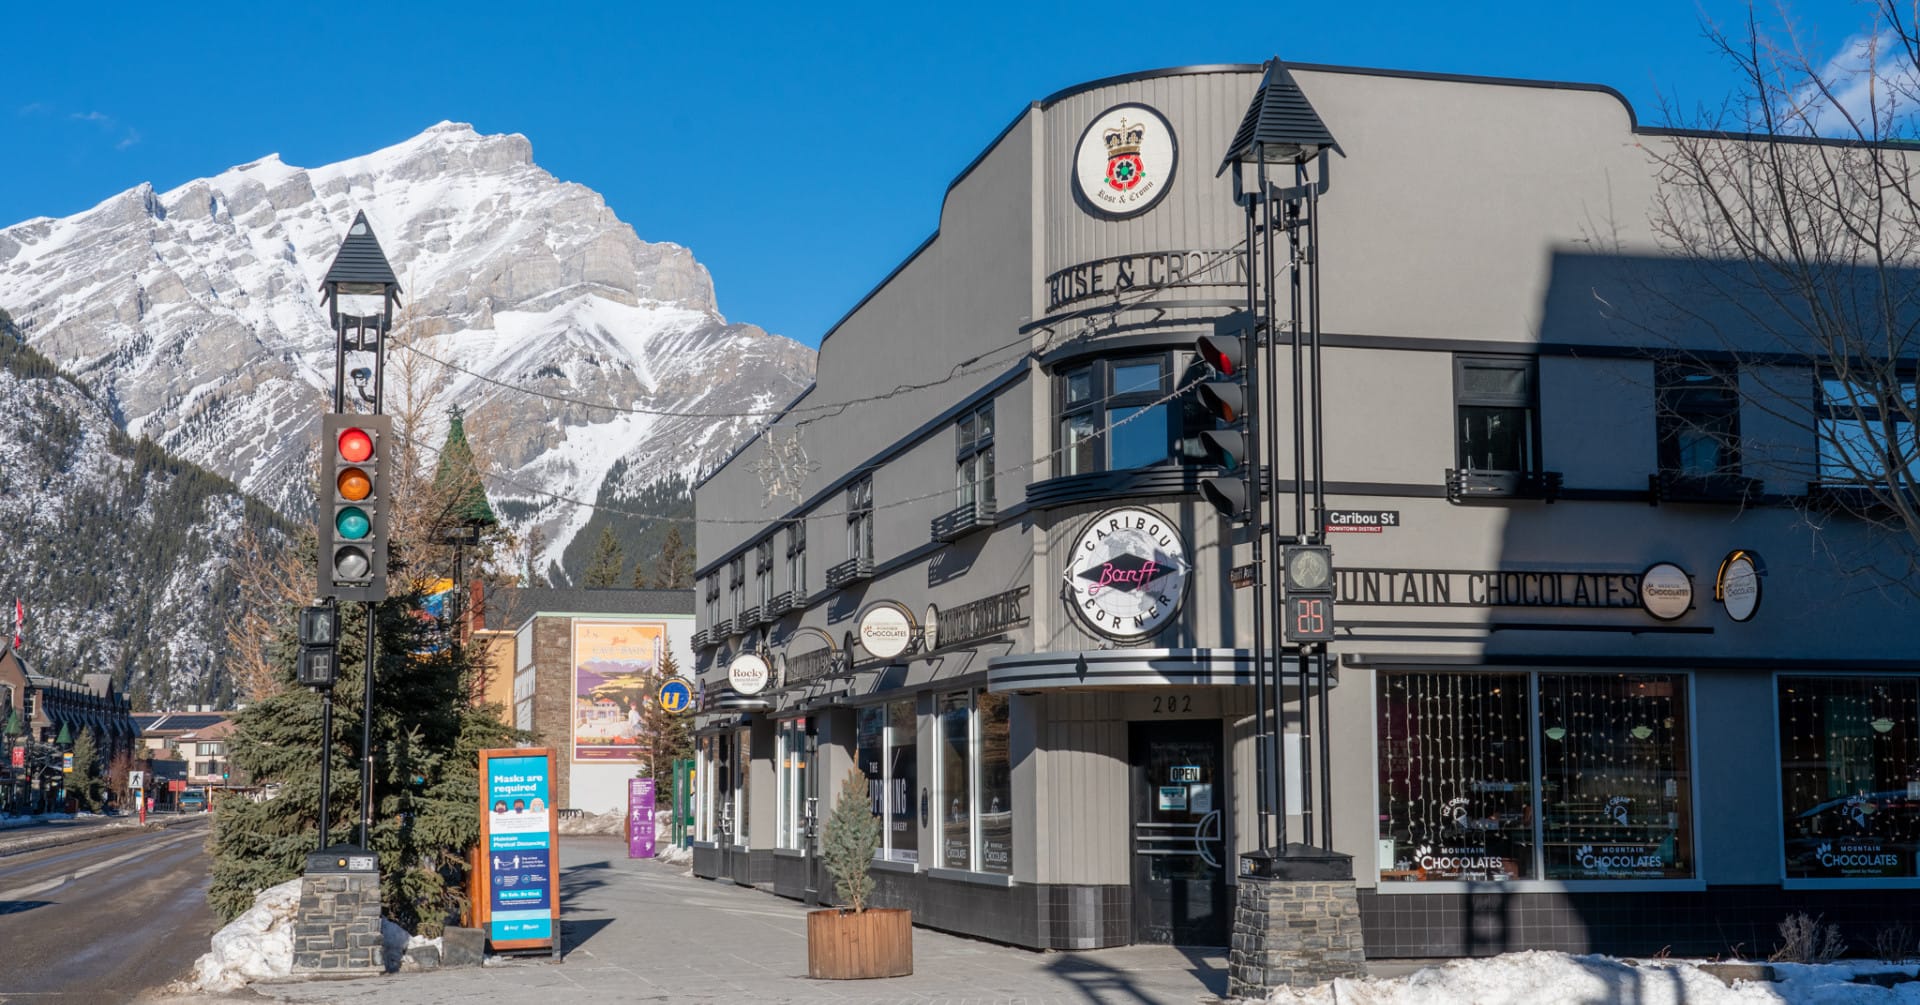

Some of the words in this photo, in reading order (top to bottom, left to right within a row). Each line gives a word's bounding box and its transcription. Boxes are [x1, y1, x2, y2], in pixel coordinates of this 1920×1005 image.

[1129, 181, 1154, 201] Crown
[1051, 264, 1104, 307] ROSE
[1117, 257, 1135, 289] &
[1149, 251, 1249, 286] CROWN
[1330, 512, 1377, 524] Caribou
[1381, 513, 1394, 524] St
[1085, 516, 1171, 552] CARIBOU
[1088, 560, 1160, 597] Banff
[1332, 571, 1449, 604] UNTAIN
[1469, 572, 1640, 607] CHOCOLATES
[1648, 588, 1689, 596] CHOCOLATES
[1085, 595, 1171, 629] CORNER
[1298, 600, 1324, 633] 25
[733, 668, 763, 678] Rocky
[1153, 695, 1192, 713] 202
[869, 762, 878, 773] THE
[1172, 767, 1197, 781] OPEN
[494, 775, 524, 783] Masks
[494, 783, 537, 795] required
[1421, 856, 1503, 869] CHOCOLATES
[1583, 855, 1662, 869] CHOCOLATES
[1822, 853, 1898, 867] CHOCOLATES
